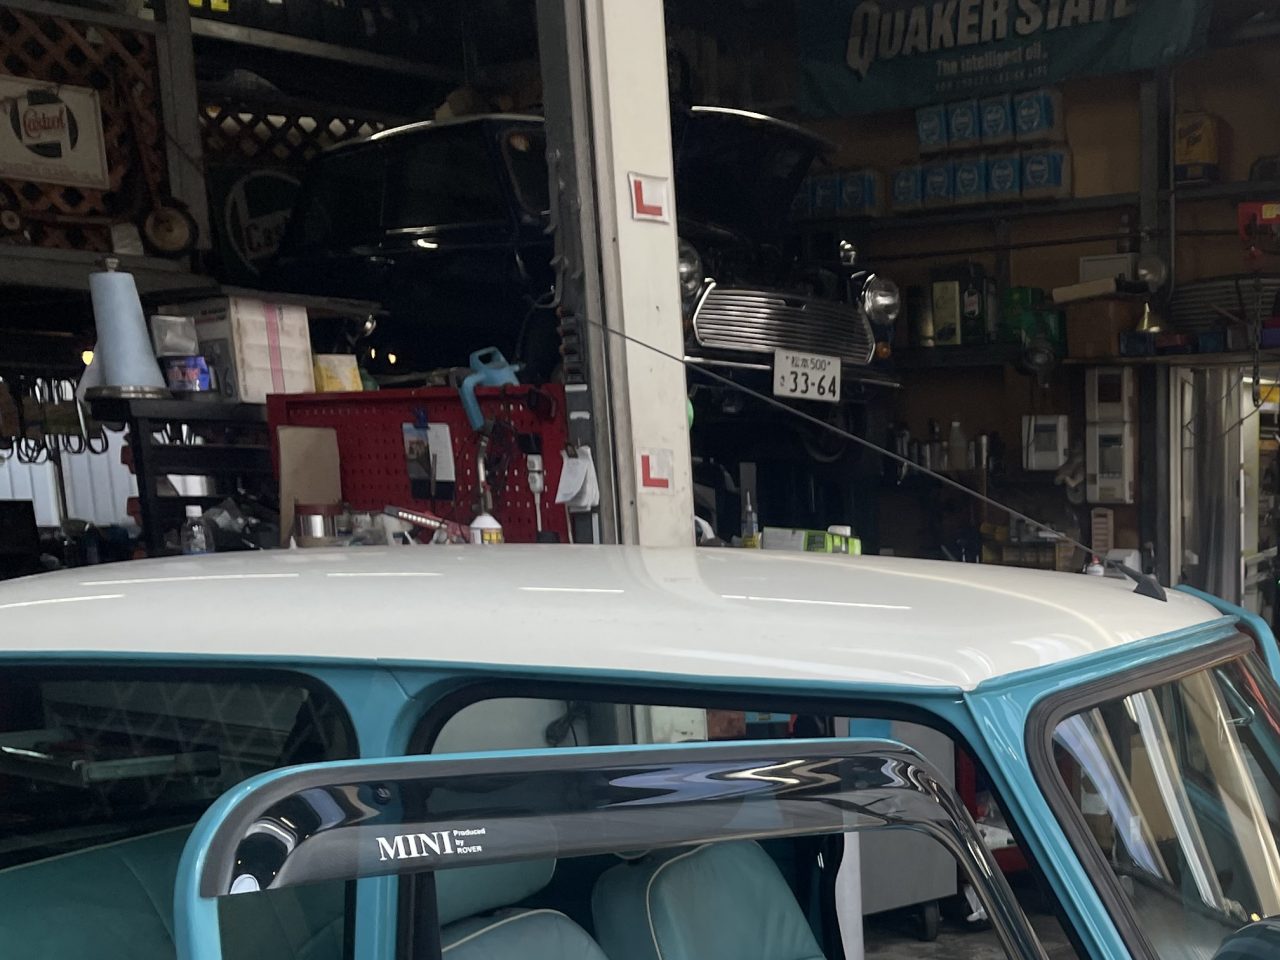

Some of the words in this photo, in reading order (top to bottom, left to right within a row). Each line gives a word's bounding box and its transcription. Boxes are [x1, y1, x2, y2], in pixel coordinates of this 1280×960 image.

[846, 0, 1008, 79] QUAKER
[634, 180, 663, 216] L
[789, 371, 837, 398] 33-64
[641, 454, 669, 488] L
[376, 831, 454, 861] MINI
[453, 828, 486, 837] Produced
[455, 839, 464, 847] by
[457, 845, 483, 855] ROVER
